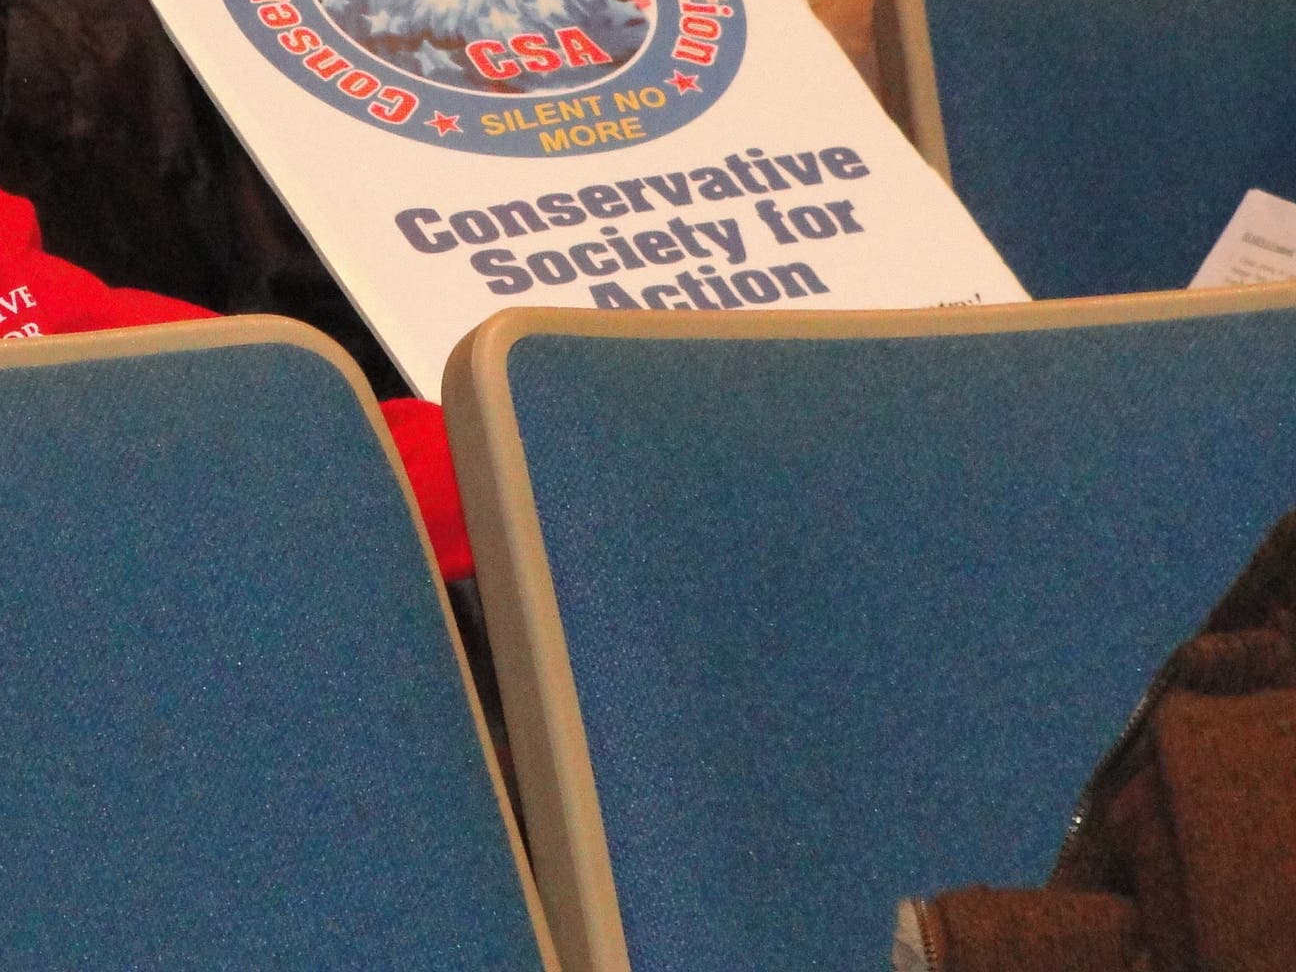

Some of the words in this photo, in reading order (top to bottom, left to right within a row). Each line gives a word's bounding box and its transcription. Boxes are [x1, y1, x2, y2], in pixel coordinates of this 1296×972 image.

[465, 26, 613, 81] CSA
[481, 95, 601, 136] SILENT
[613, 86, 666, 112] NO
[539, 117, 646, 152] MORE
[394, 141, 871, 254] Conservative
[470, 214, 747, 295] Society
[755, 194, 865, 244] for
[589, 262, 830, 310] Action
